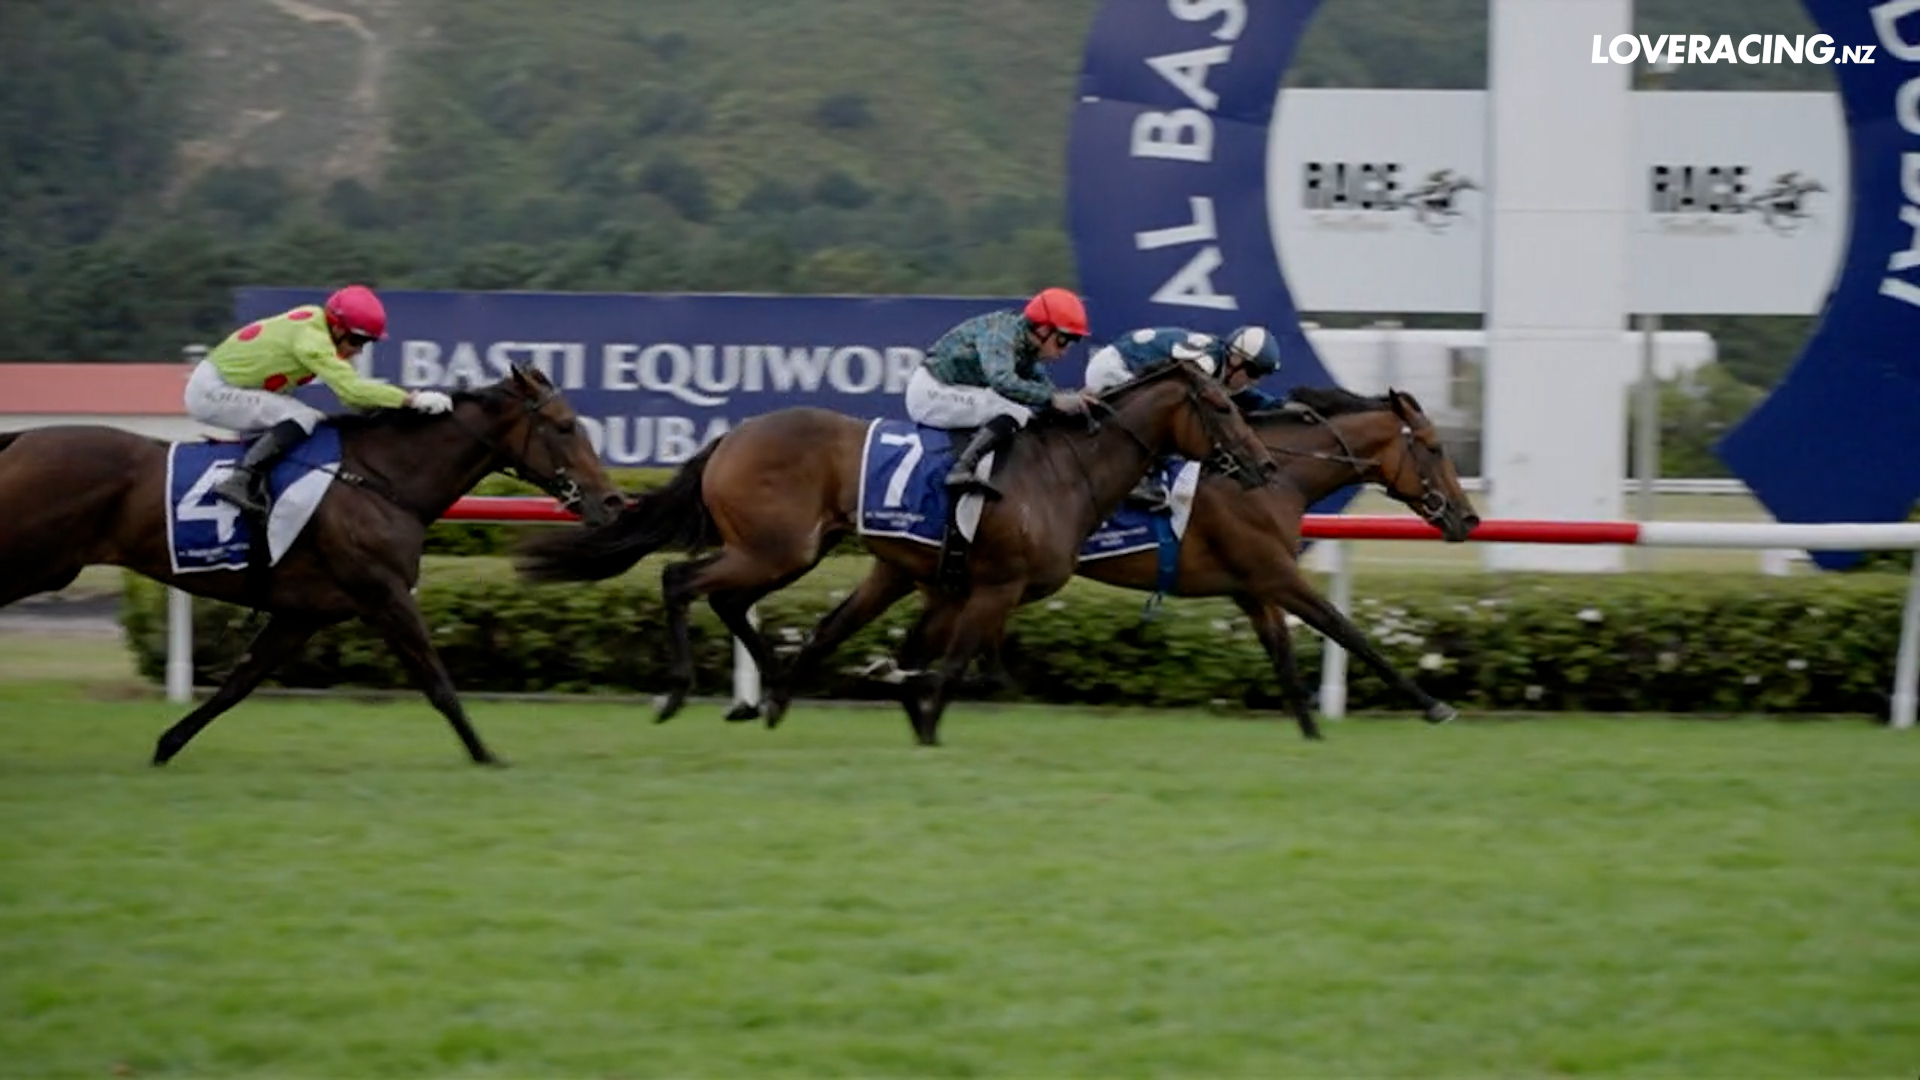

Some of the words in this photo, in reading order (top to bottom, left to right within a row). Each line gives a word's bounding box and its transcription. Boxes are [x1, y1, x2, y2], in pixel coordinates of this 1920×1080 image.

[1134, 196, 1239, 310] AL
[401, 341, 585, 389] BASTI
[176, 459, 241, 543] 4
[880, 433, 922, 507] 7
